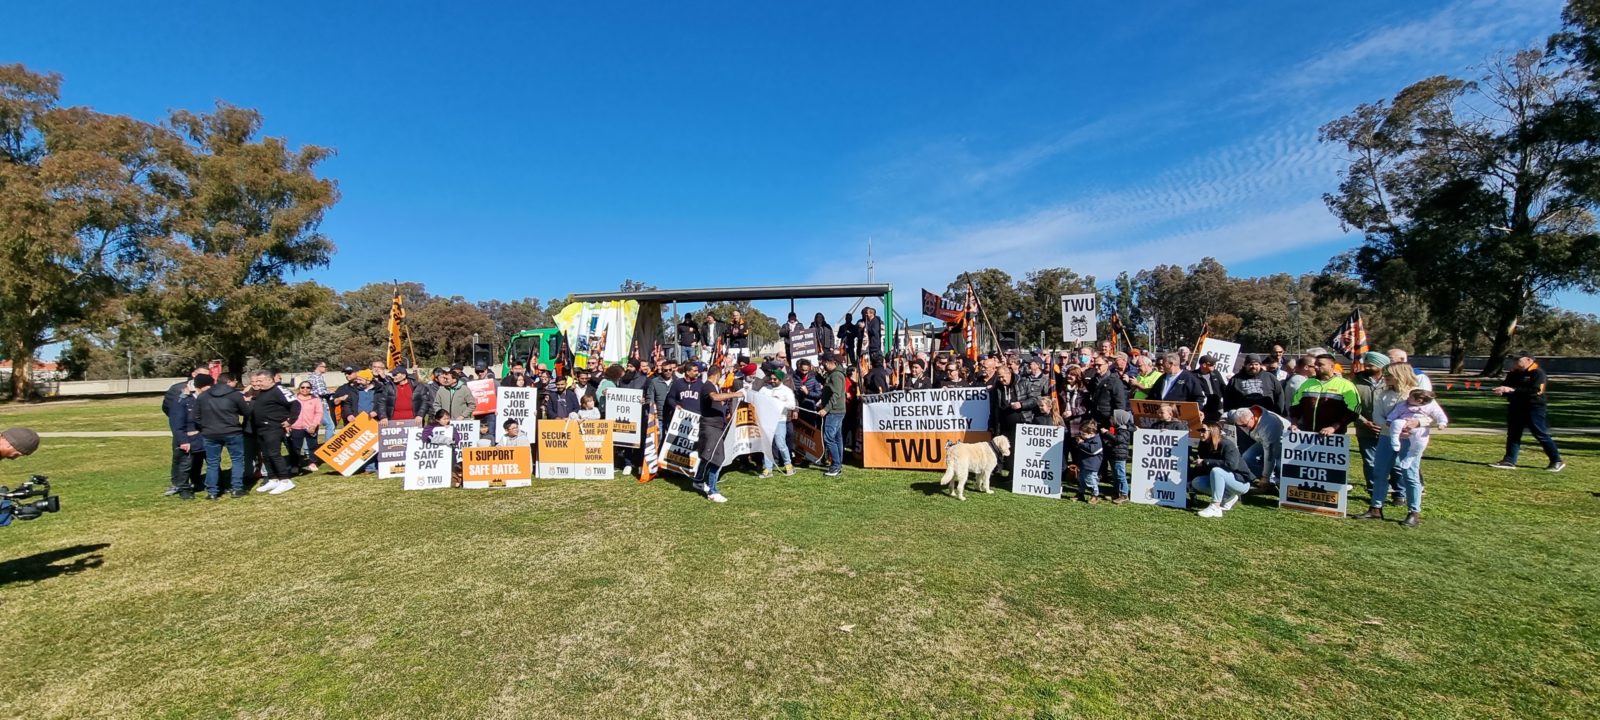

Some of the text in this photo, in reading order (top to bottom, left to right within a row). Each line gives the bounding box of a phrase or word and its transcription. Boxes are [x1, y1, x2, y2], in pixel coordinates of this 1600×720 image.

[940, 297, 964, 312] TWU
[1062, 298, 1094, 312] TWU
[791, 334, 803, 342] STOP
[1206, 350, 1231, 364] SAFE
[1216, 363, 1230, 374] RK
[503, 390, 530, 400] SAME
[607, 392, 641, 404] FAMILIES
[679, 389, 699, 400] POLO
[864, 389, 988, 404] TRANSPORT WORKERS
[507, 400, 525, 408] JOB
[616, 405, 631, 414] FOR
[1137, 402, 1182, 417] I SUPT
[503, 408, 529, 417] SAME
[678, 409, 701, 424] OWN
[893, 404, 955, 417] DESERVE A
[671, 421, 699, 437] DRIVE
[878, 418, 973, 431] SAFER INDUSTRY
[381, 427, 402, 436] STOP
[541, 431, 571, 440] SECURE
[1021, 426, 1058, 438] SECURE
[322, 423, 361, 457] I SUPPORT
[383, 438, 408, 446] amaz
[418, 442, 440, 450] JOB
[545, 440, 568, 449] WORK
[676, 437, 694, 449] FOR
[1026, 437, 1052, 448] JOBS
[1142, 434, 1179, 447] SAME
[1288, 432, 1344, 448] OWNER
[332, 447, 355, 466] SAFE
[413, 449, 444, 460] SAME
[469, 450, 473, 462] I
[475, 449, 515, 461] SUPPORT
[885, 438, 942, 463] TWU
[1147, 446, 1172, 458] JOB
[1284, 448, 1346, 466] DRIVERS
[418, 459, 438, 470] PAY
[468, 463, 522, 476] SAFE RATES.
[1025, 458, 1051, 470] SAFE
[1141, 457, 1178, 471] SAME
[593, 467, 607, 475] TWU
[1021, 468, 1054, 481] ROADS
[1147, 470, 1171, 482] PAY
[1299, 466, 1328, 482] FOR
[427, 475, 443, 484] TWU
[1027, 484, 1051, 495] TWU
[1156, 489, 1175, 500] TWU
[1288, 489, 1309, 499] SAFE
[1311, 492, 1336, 503] RATES
